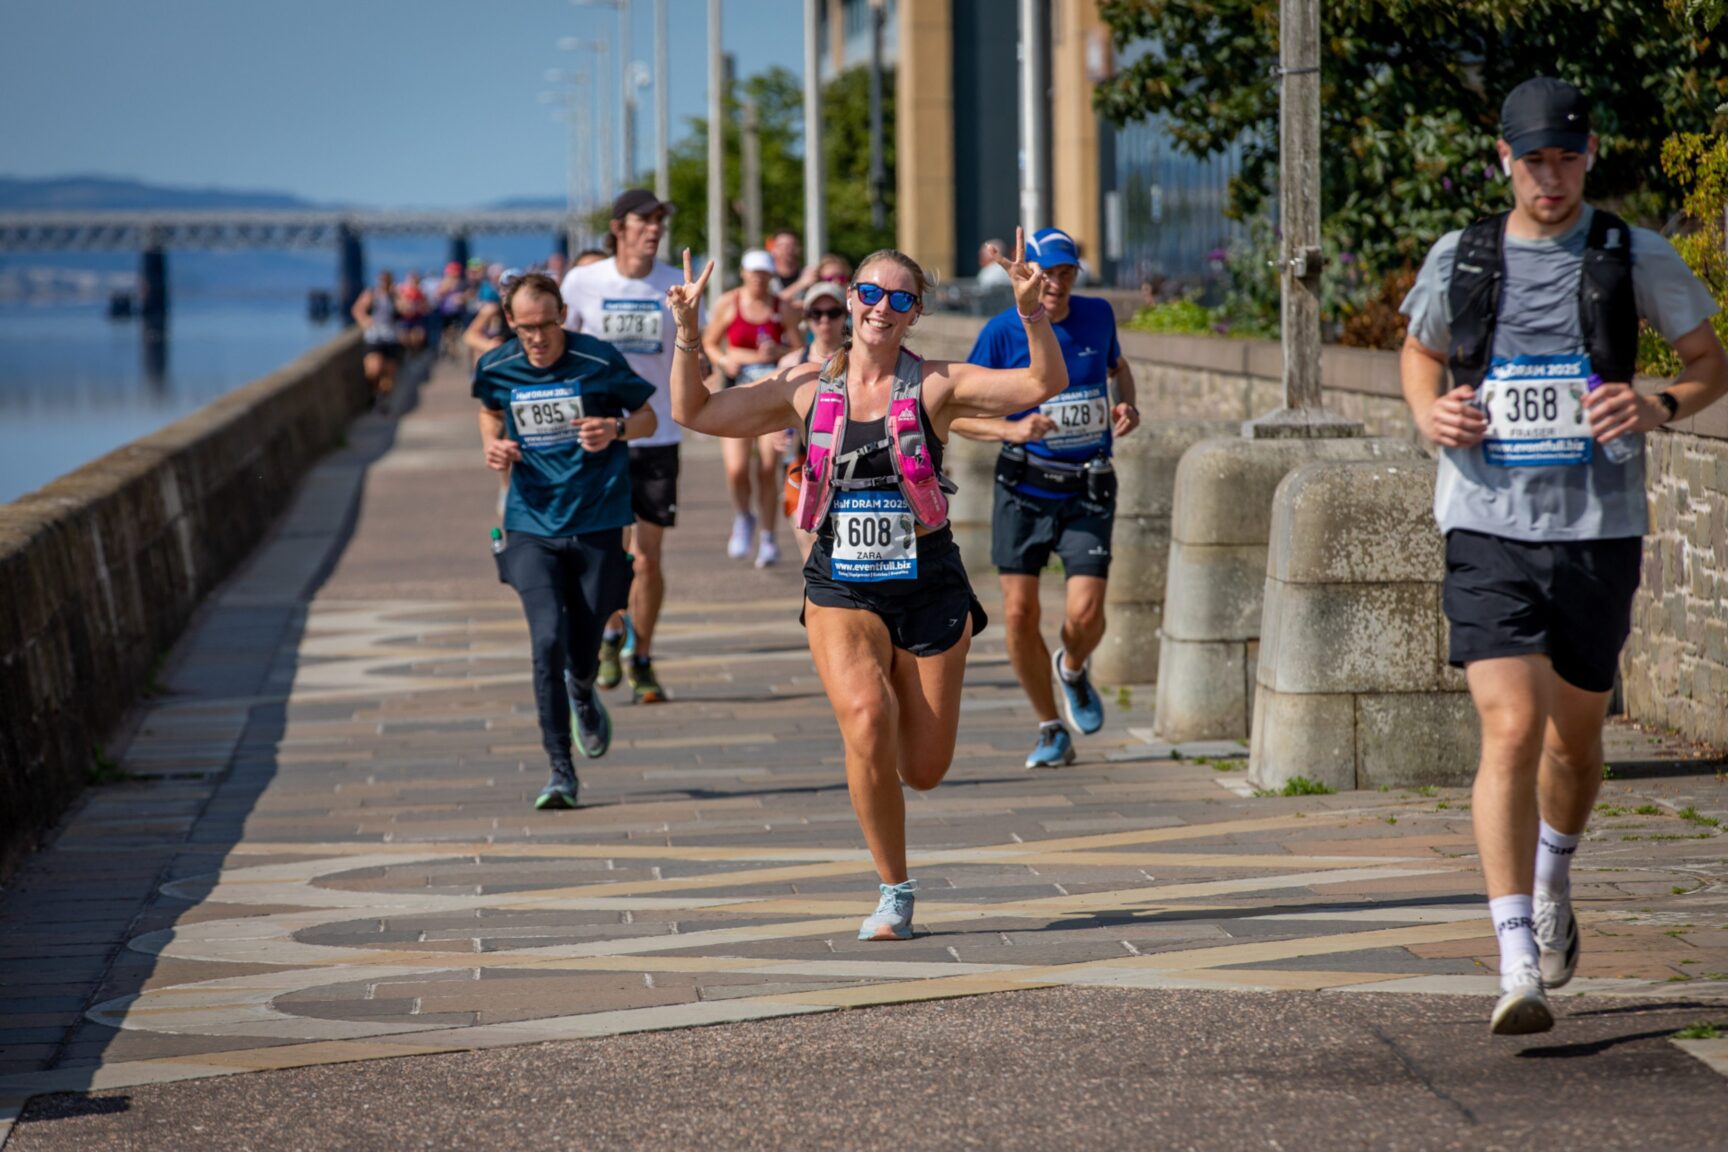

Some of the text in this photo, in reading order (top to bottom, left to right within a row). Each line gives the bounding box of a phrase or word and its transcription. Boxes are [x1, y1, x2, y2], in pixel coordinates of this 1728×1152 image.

[1547, 362, 1581, 376] 2025
[1506, 387, 1557, 422] 368
[531, 402, 565, 425] 895
[1061, 404, 1091, 427] 428
[1511, 428, 1555, 437] FRASER
[833, 499, 908, 509] Half DRAM 2025
[848, 517, 892, 547] 608
[856, 551, 882, 560] ZARA
[834, 560, 912, 571] www.eventfull.biz
